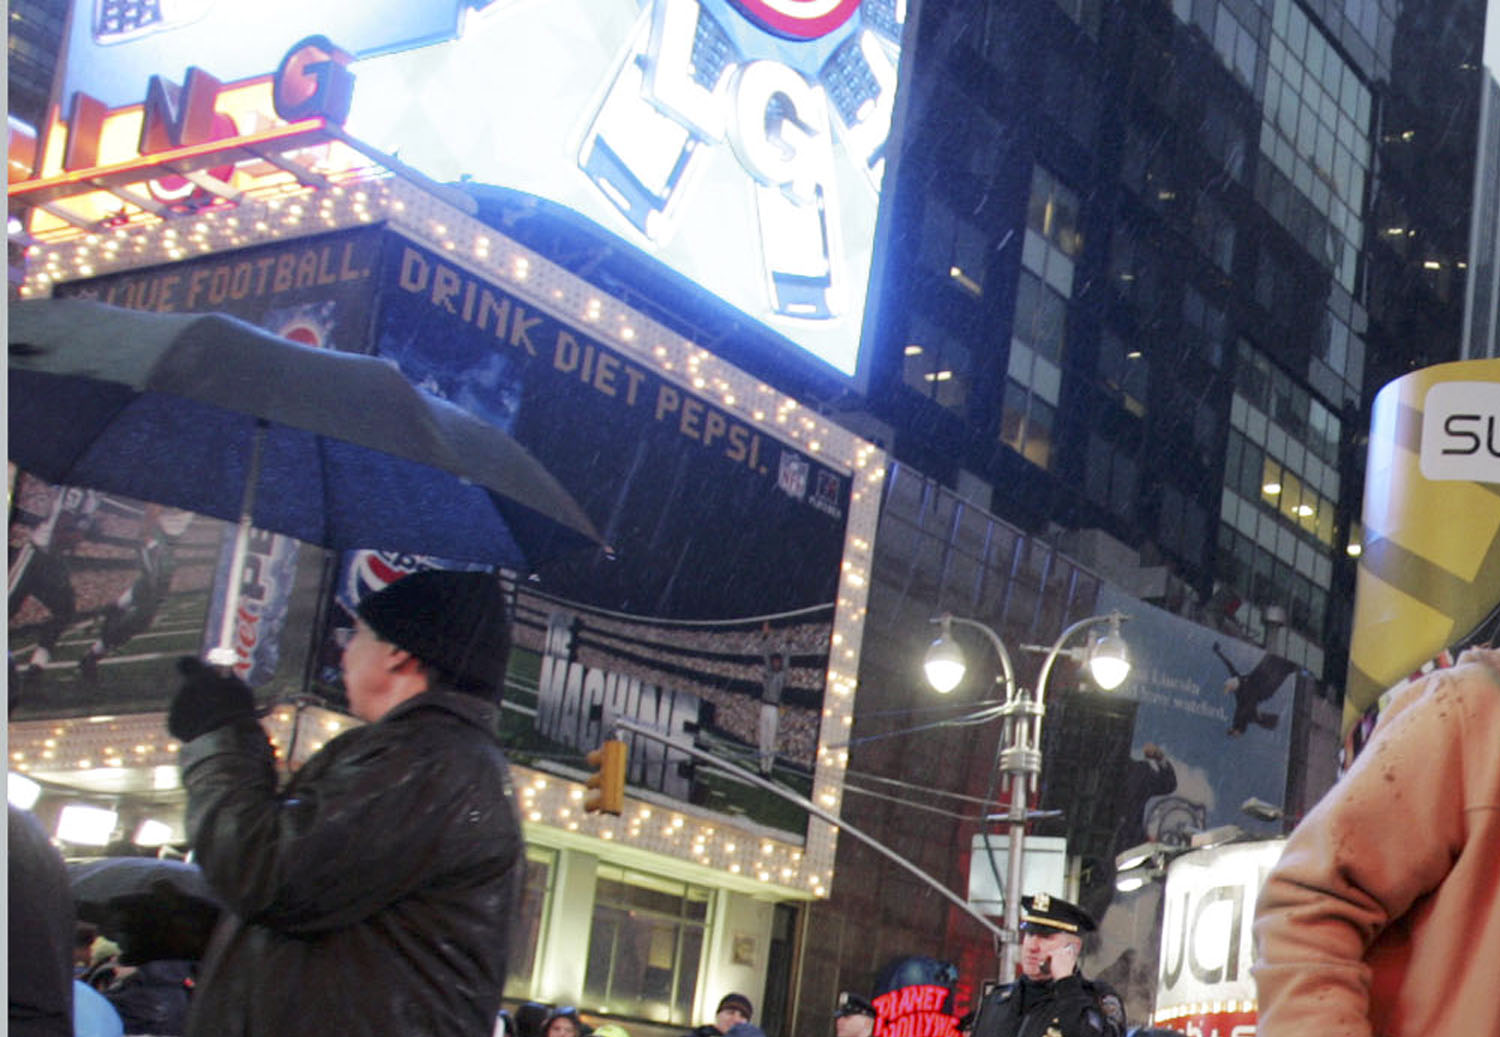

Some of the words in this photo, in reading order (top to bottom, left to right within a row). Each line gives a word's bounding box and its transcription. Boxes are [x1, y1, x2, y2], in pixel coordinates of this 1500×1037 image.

[400, 246, 544, 356] DRINK
[553, 333, 648, 406] DIET
[655, 385, 768, 475] PEPSI.
[871, 984, 950, 1020] PLANET
